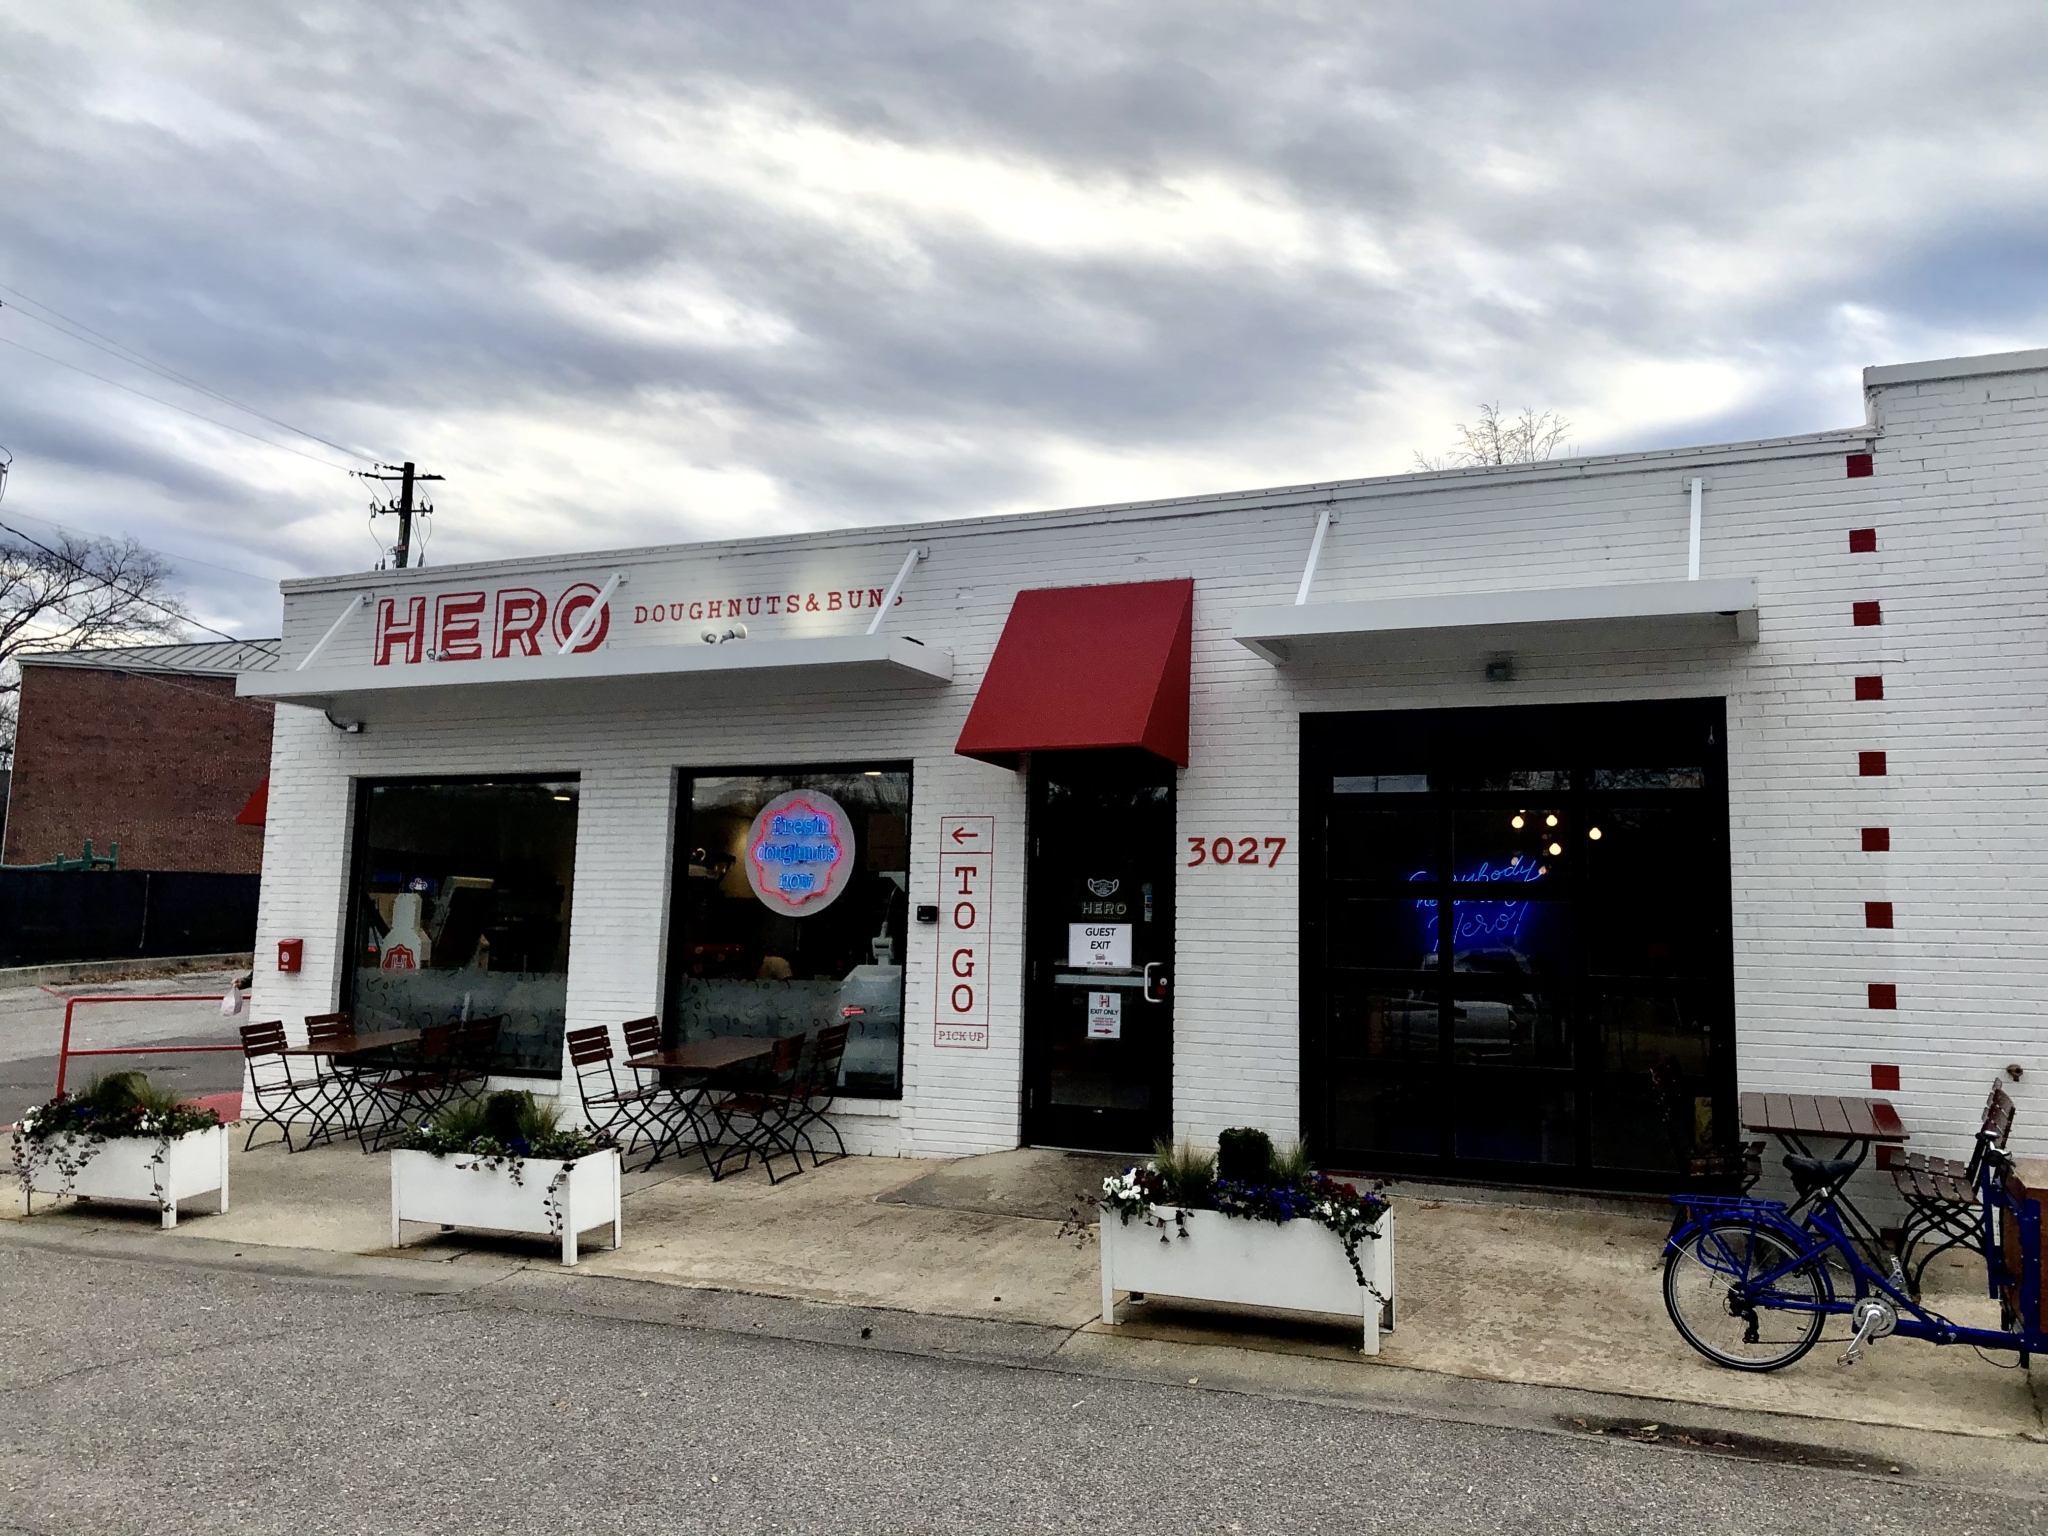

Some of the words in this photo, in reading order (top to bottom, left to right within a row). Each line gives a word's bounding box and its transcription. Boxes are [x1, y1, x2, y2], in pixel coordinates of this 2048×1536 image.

[374, 582, 610, 666] HERO
[772, 815, 827, 835] fresh
[756, 842, 837, 866] doughnuts
[1187, 836, 1286, 868] 3027
[779, 873, 814, 890] now
[1081, 901, 1127, 915] HERO
[1085, 927, 1116, 937] GUEST
[1090, 940, 1111, 950] EXIT
[1099, 994, 1110, 1008] H
